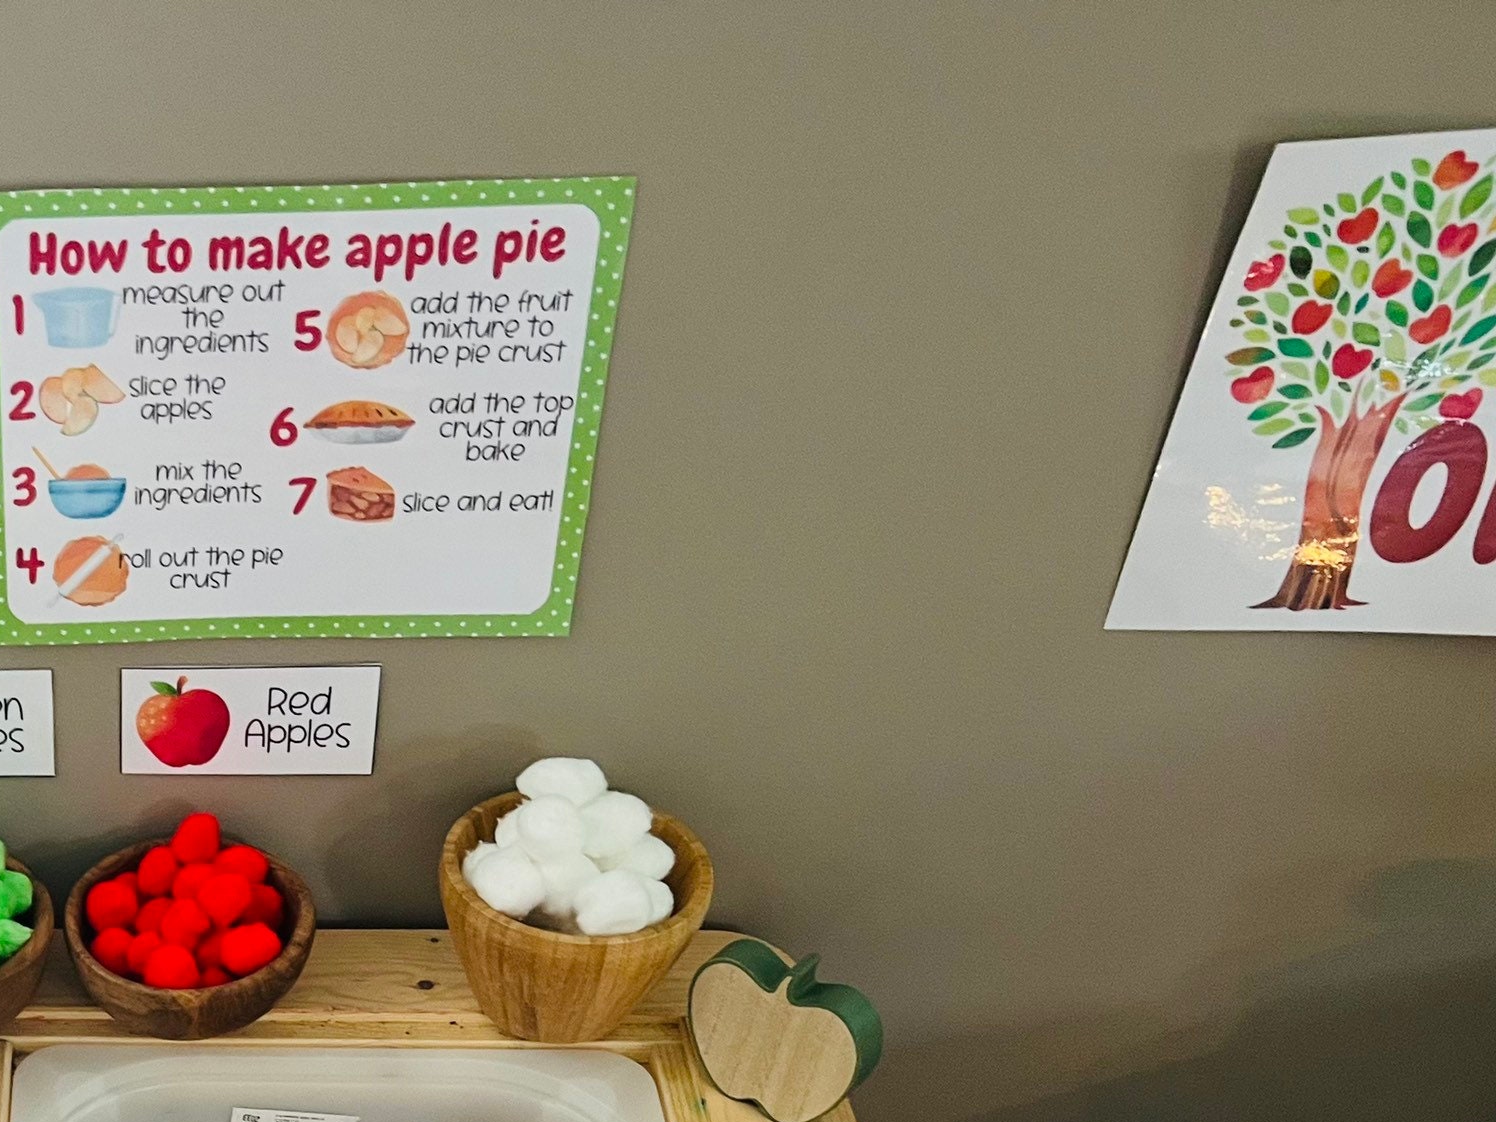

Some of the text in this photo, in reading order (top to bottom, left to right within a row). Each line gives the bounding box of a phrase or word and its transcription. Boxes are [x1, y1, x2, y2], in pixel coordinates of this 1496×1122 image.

[30, 219, 565, 282] How to make apple pie
[13, 280, 285, 335] 1 measure out
[182, 307, 224, 328] the
[295, 290, 573, 351] 5 add the fruit
[423, 316, 554, 338] mixture to
[136, 331, 268, 360] ingredients
[407, 341, 566, 367] the pie crust
[9, 375, 225, 420] 2 slice the
[141, 398, 212, 424] apples
[270, 392, 573, 446] 6 add the top
[439, 416, 558, 439] crust and
[466, 441, 525, 461] bake
[12, 460, 242, 506] 3 mix the
[135, 483, 261, 510] ingredients
[289, 477, 553, 515] 7 slice and eat!
[16, 547, 283, 584] 4 roll out the pie
[170, 569, 231, 589] crust
[268, 687, 332, 715] Red
[245, 719, 351, 753] Apples
